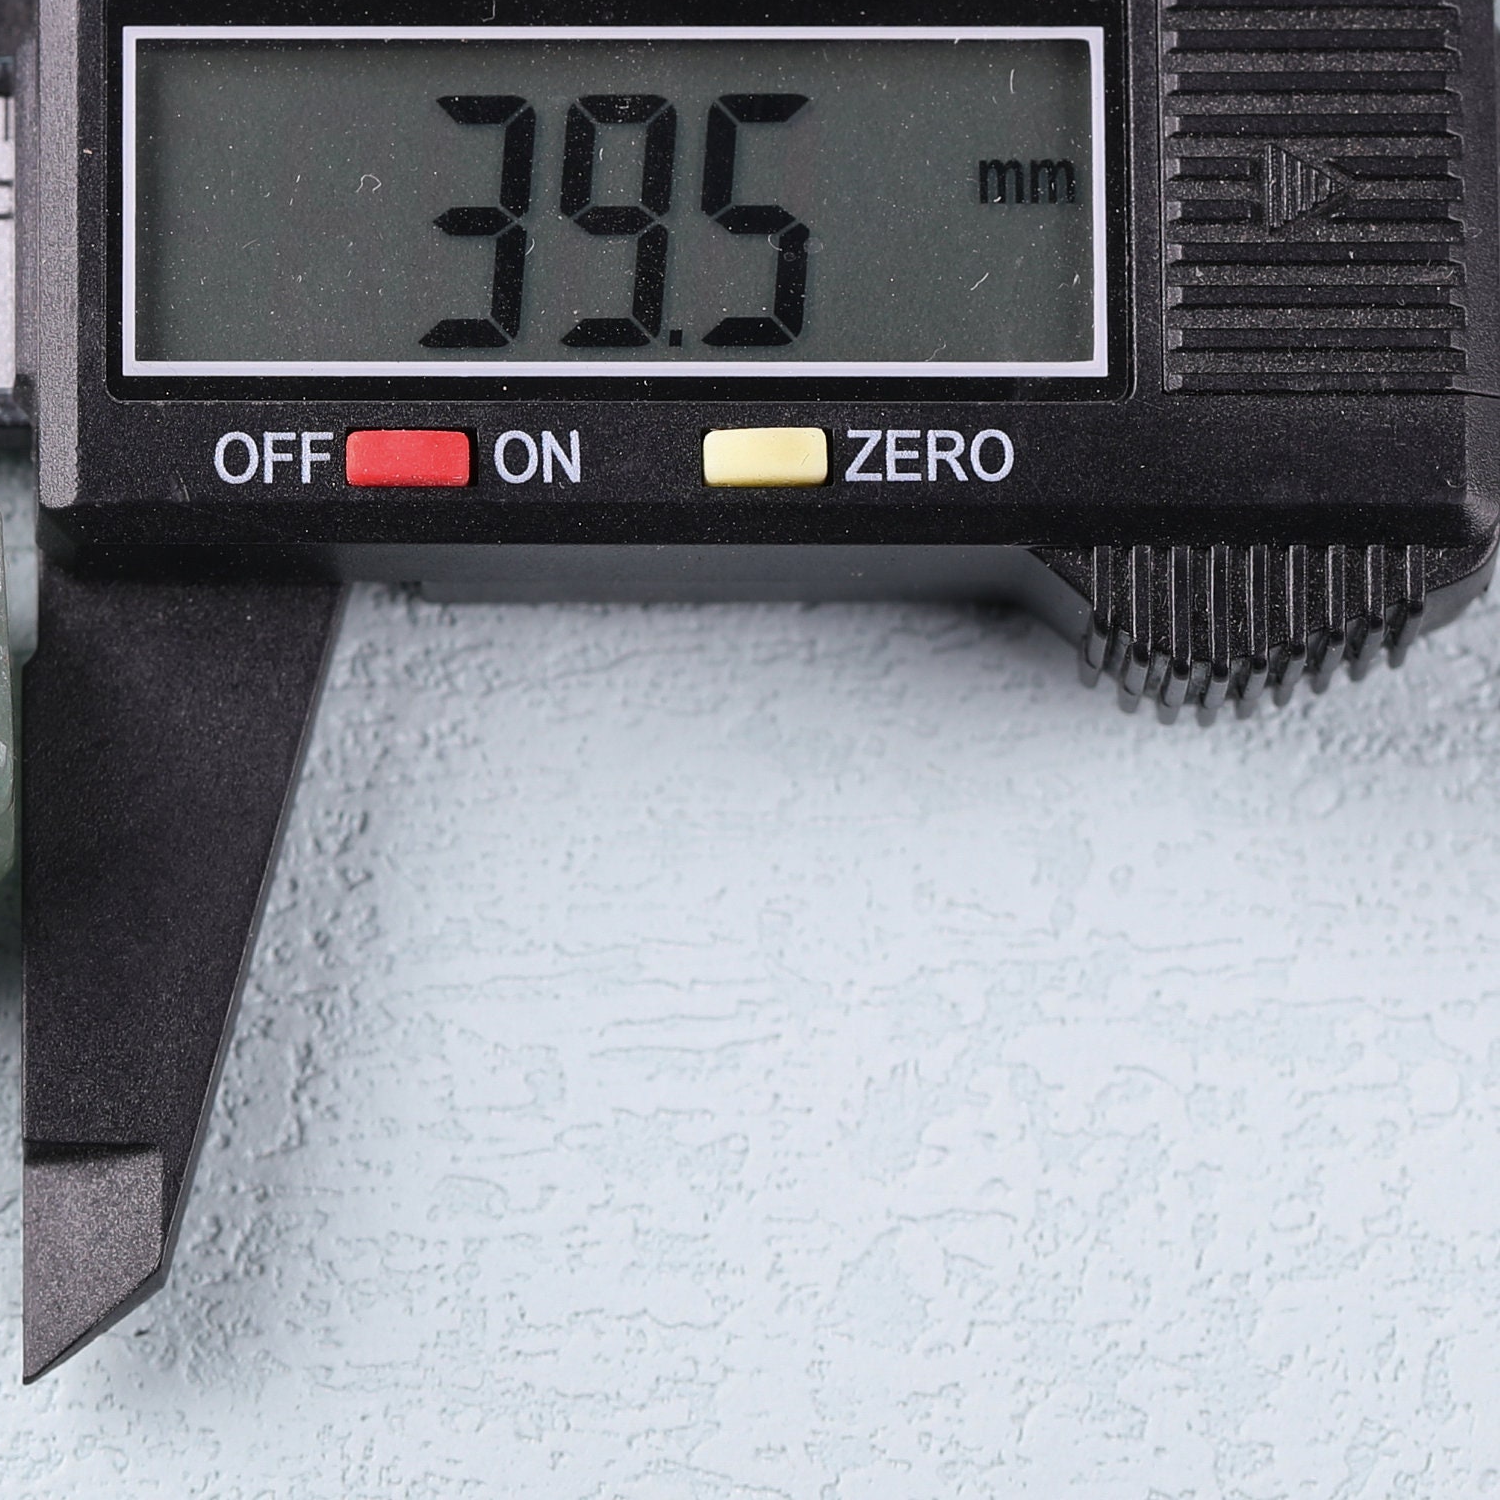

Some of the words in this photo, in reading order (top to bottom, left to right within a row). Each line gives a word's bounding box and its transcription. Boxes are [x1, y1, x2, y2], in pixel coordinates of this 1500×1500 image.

[418, 93, 812, 348] 39.5
[978, 156, 1077, 206] mm
[213, 430, 334, 485] OFF
[493, 429, 581, 484] ON
[845, 428, 1015, 482] ZERO
